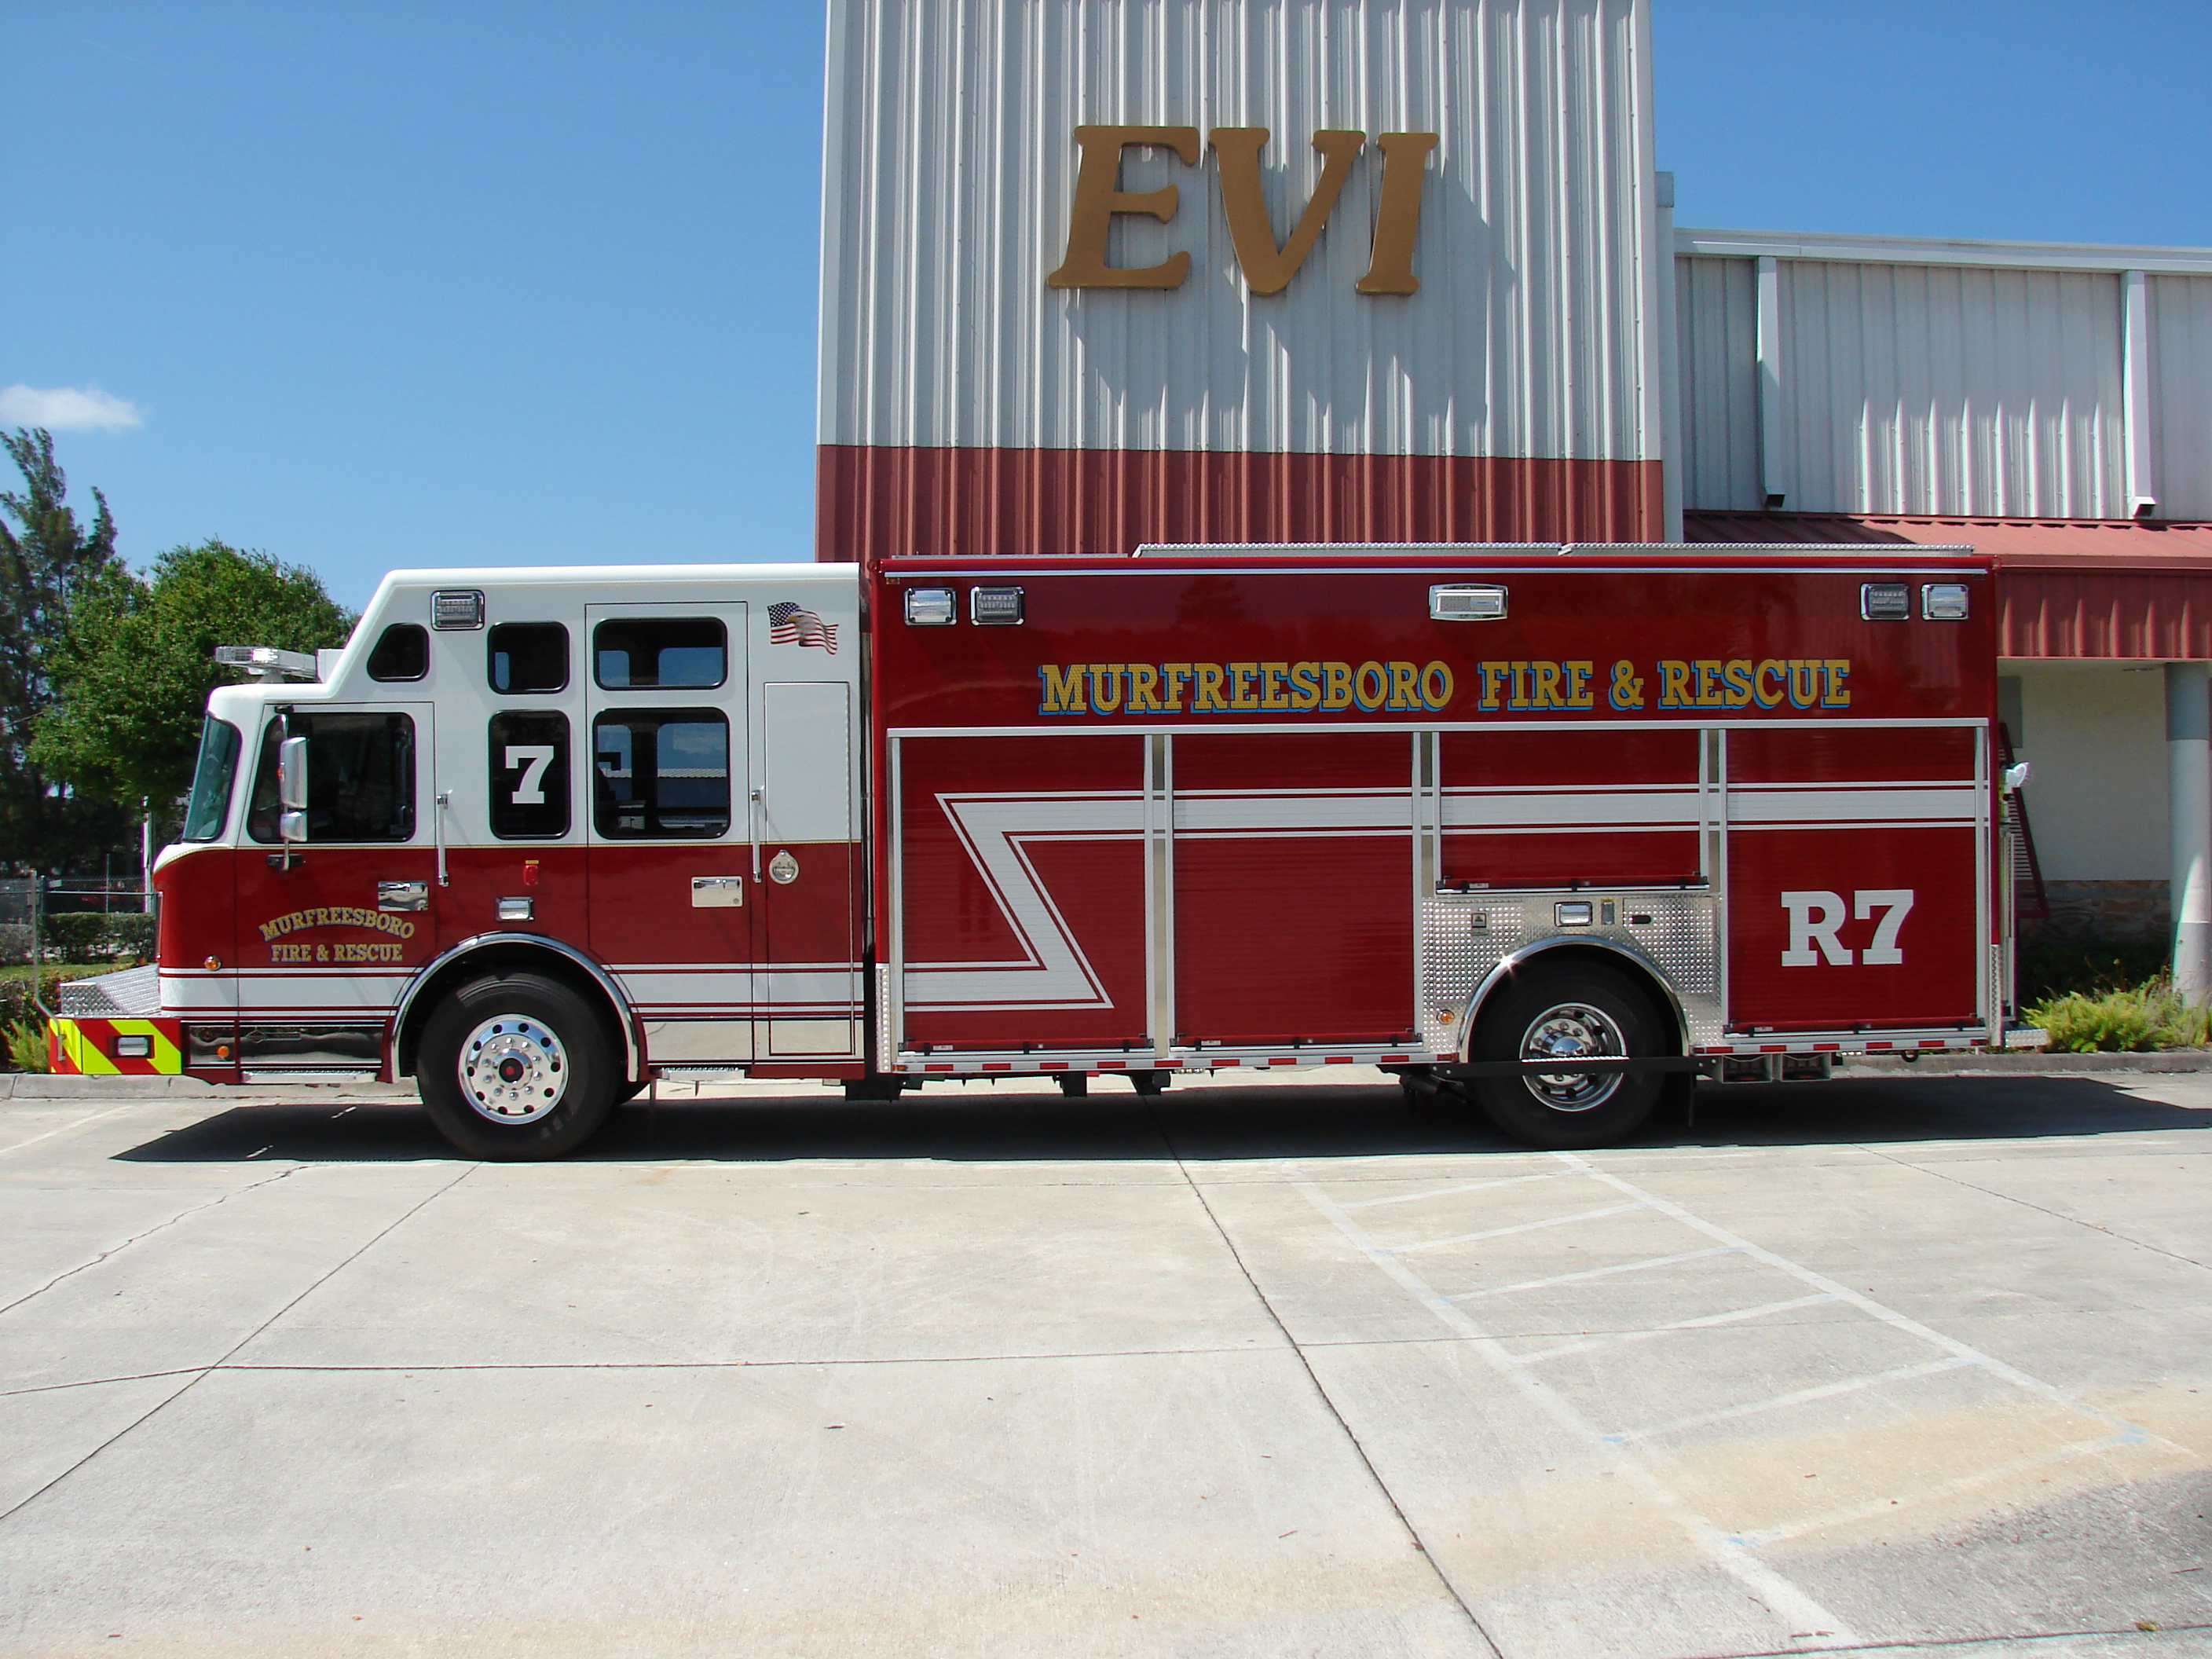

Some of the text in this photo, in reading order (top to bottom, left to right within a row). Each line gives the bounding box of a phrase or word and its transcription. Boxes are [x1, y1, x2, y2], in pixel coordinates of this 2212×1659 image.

[1048, 126, 1439, 296] EVI
[1038, 658, 1851, 716] MURFREESBORO FIRE & RESCUE
[505, 745, 555, 804] 7
[258, 907, 415, 942] MURFREESBORO
[270, 943, 403, 962] FIRE & RESCUE
[1781, 889, 1914, 967] R7
